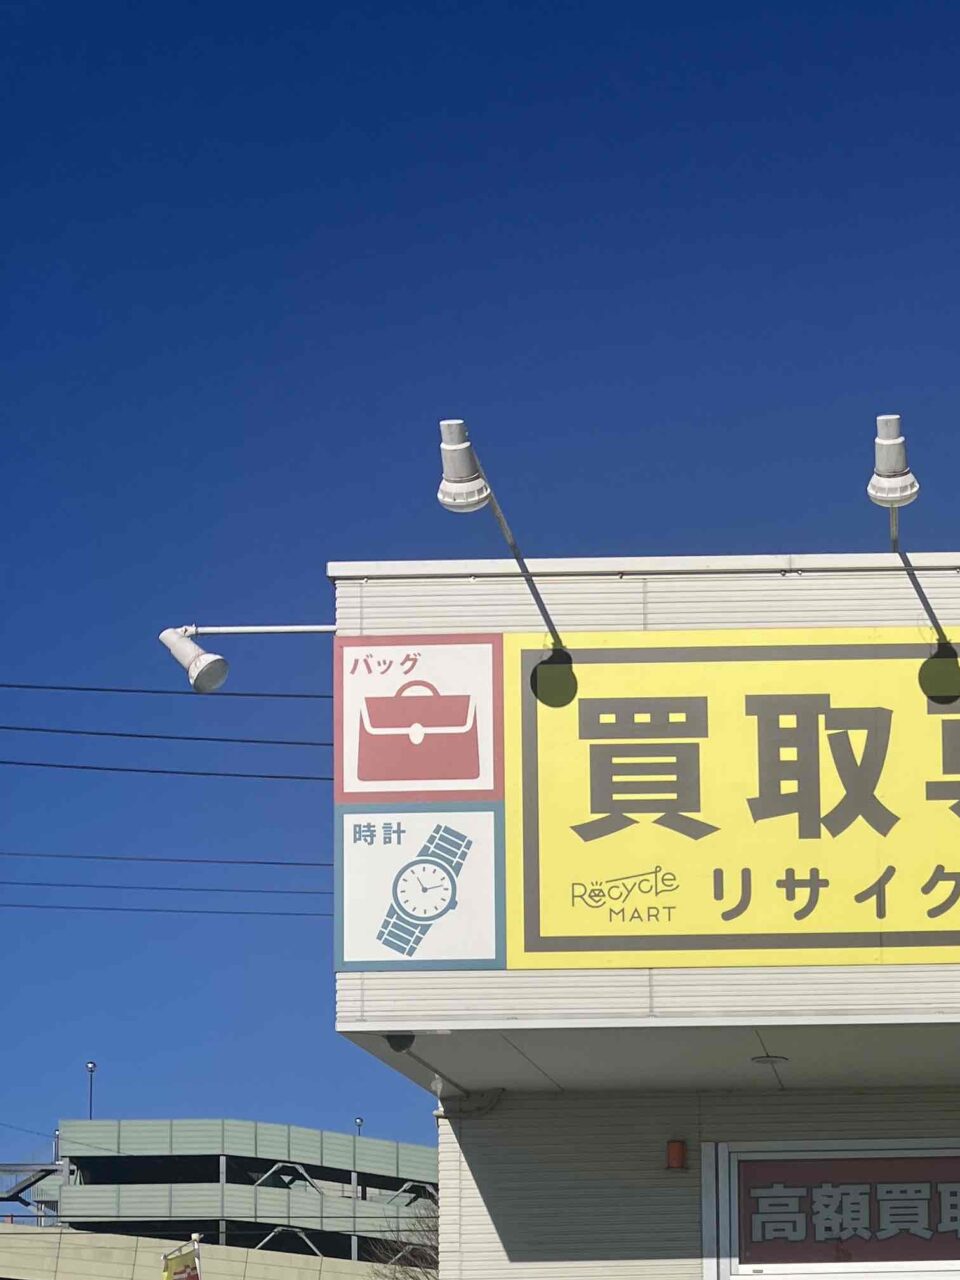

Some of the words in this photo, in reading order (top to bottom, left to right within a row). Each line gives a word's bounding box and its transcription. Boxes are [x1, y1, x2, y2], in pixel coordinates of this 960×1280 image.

[349, 652, 422, 676] バッグ
[352, 822, 406, 846] 時計
[608, 906, 678, 923] MART
